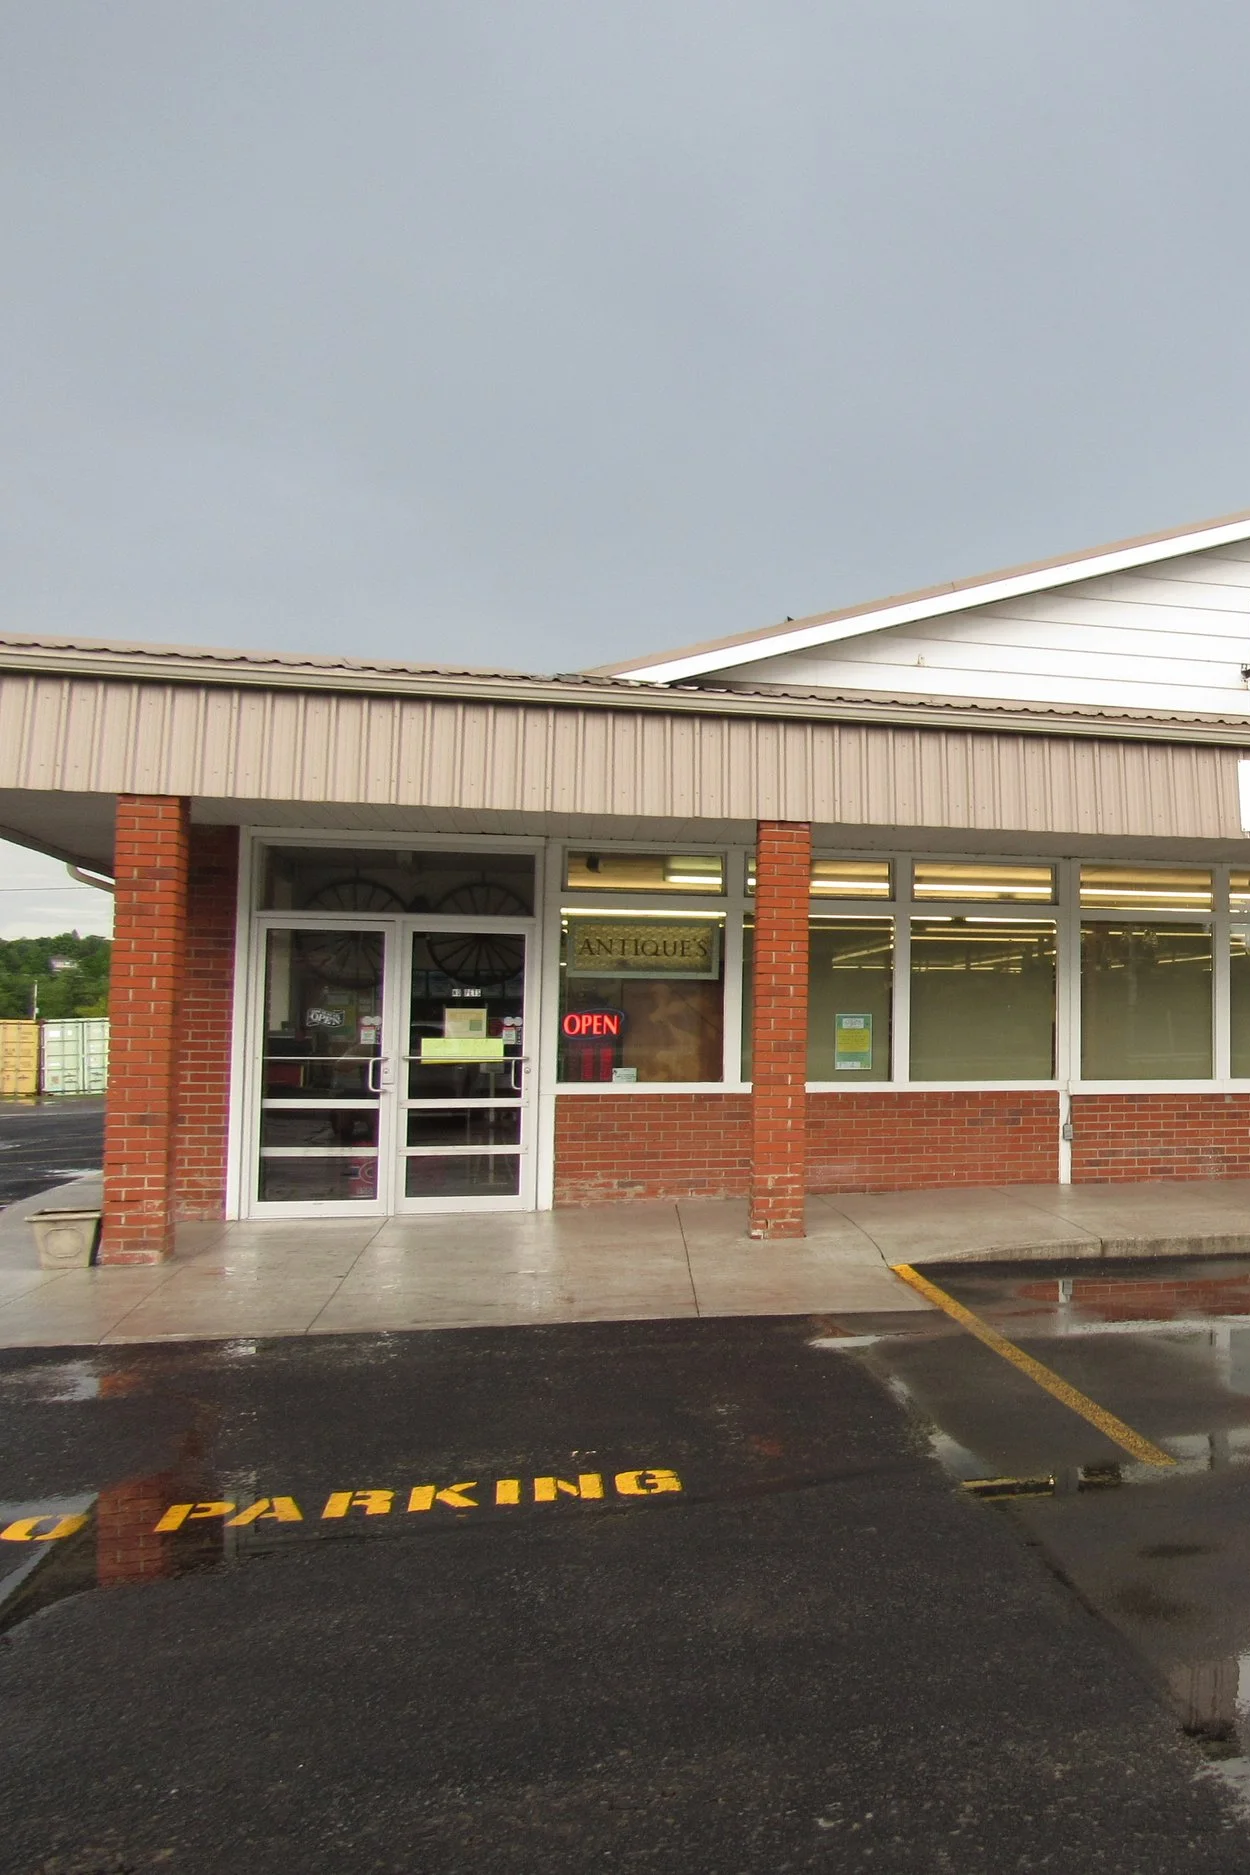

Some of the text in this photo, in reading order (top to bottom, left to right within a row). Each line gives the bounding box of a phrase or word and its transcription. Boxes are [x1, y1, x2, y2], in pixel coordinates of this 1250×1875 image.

[563, 1013, 619, 1036] OPEN
[0, 1469, 682, 1542] O PARKING
